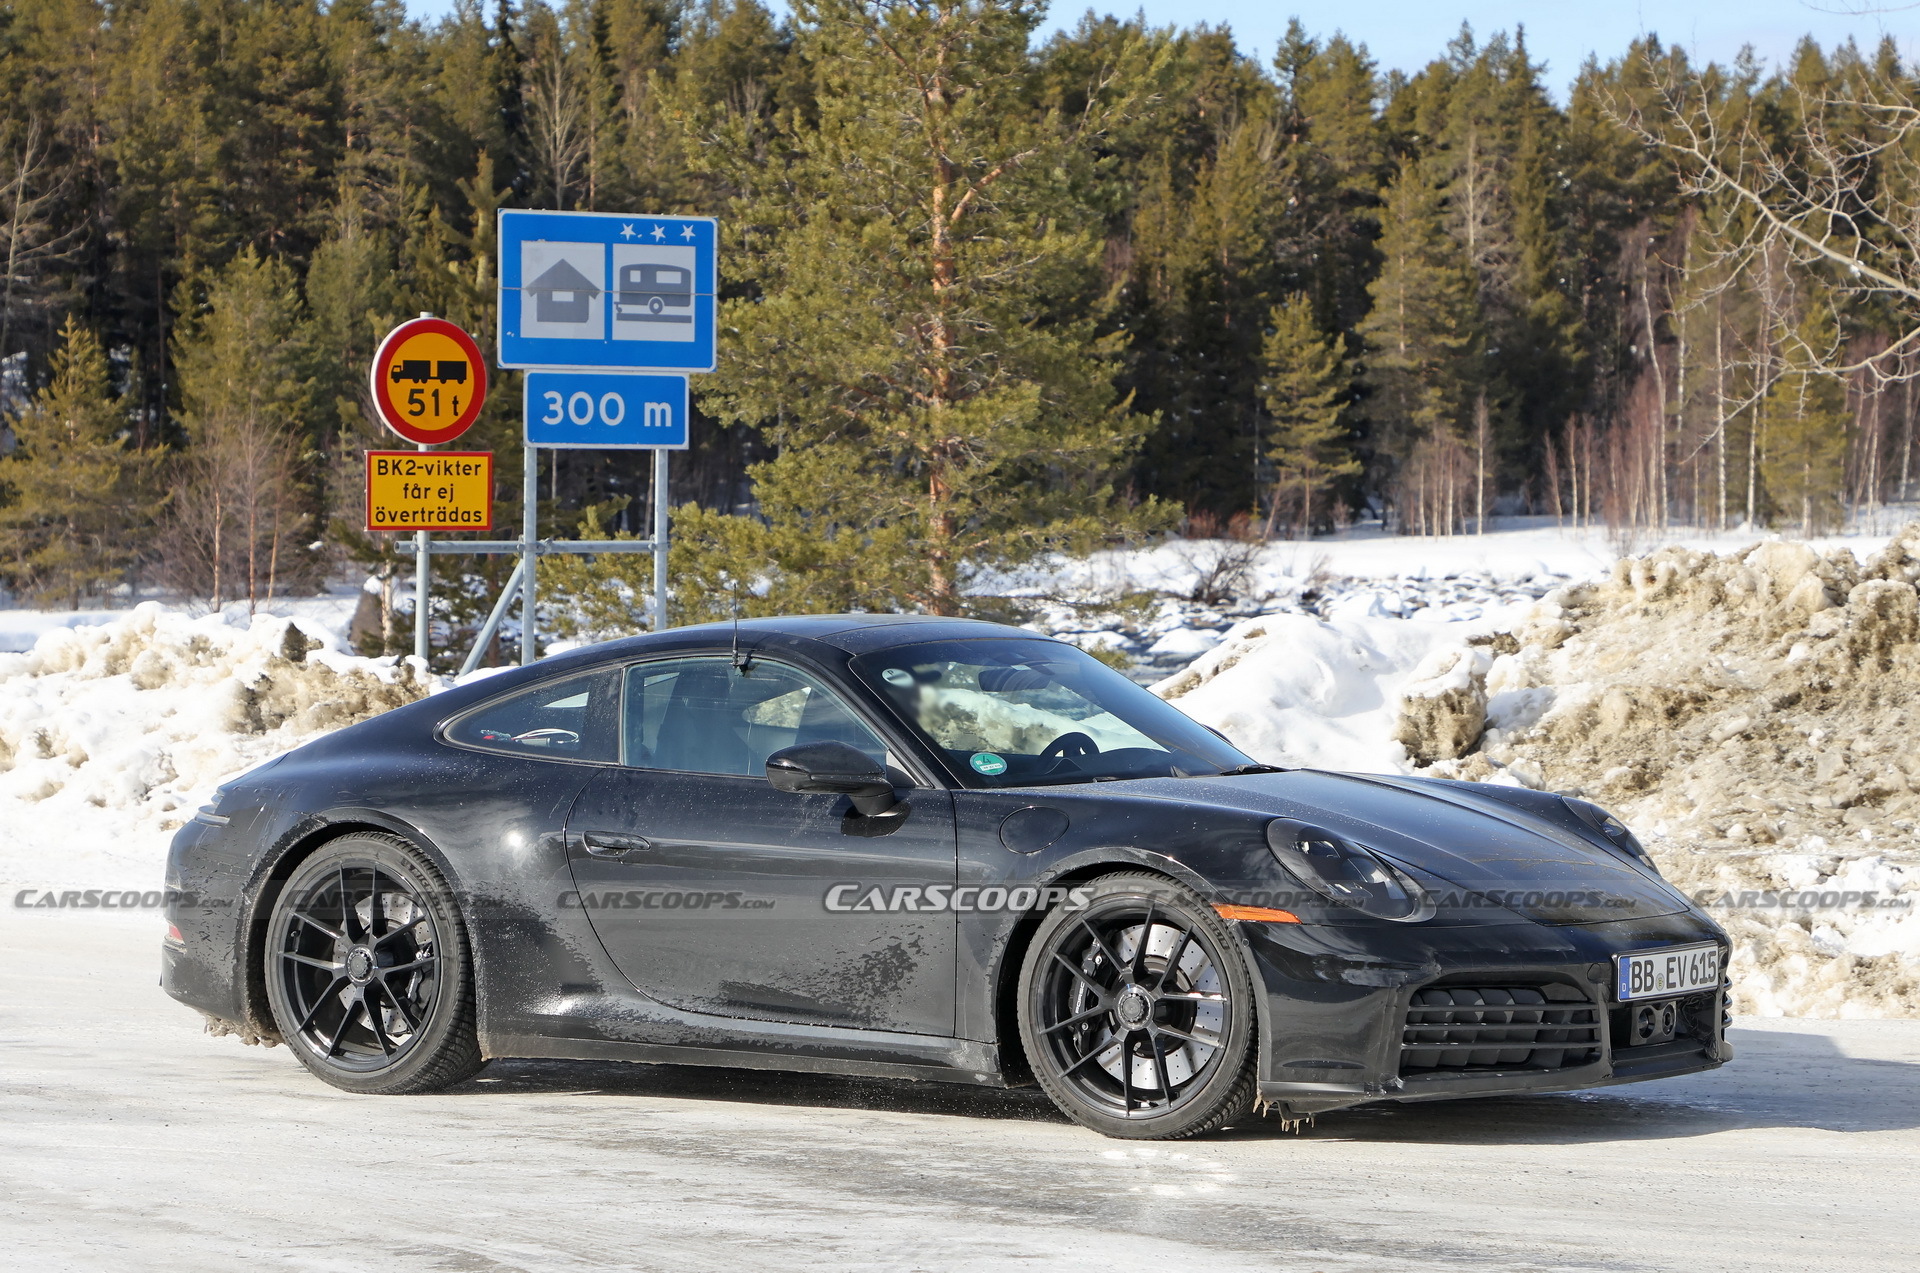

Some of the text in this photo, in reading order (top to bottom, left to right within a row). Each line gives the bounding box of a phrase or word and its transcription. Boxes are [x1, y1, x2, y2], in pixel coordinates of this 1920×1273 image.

[407, 389, 459, 417] 51 t
[541, 391, 673, 427] 300 m
[377, 459, 481, 476] BK2-vikter
[402, 483, 455, 503] får ej
[375, 506, 482, 523] överträdas
[1631, 950, 1717, 993] BB EV 615
